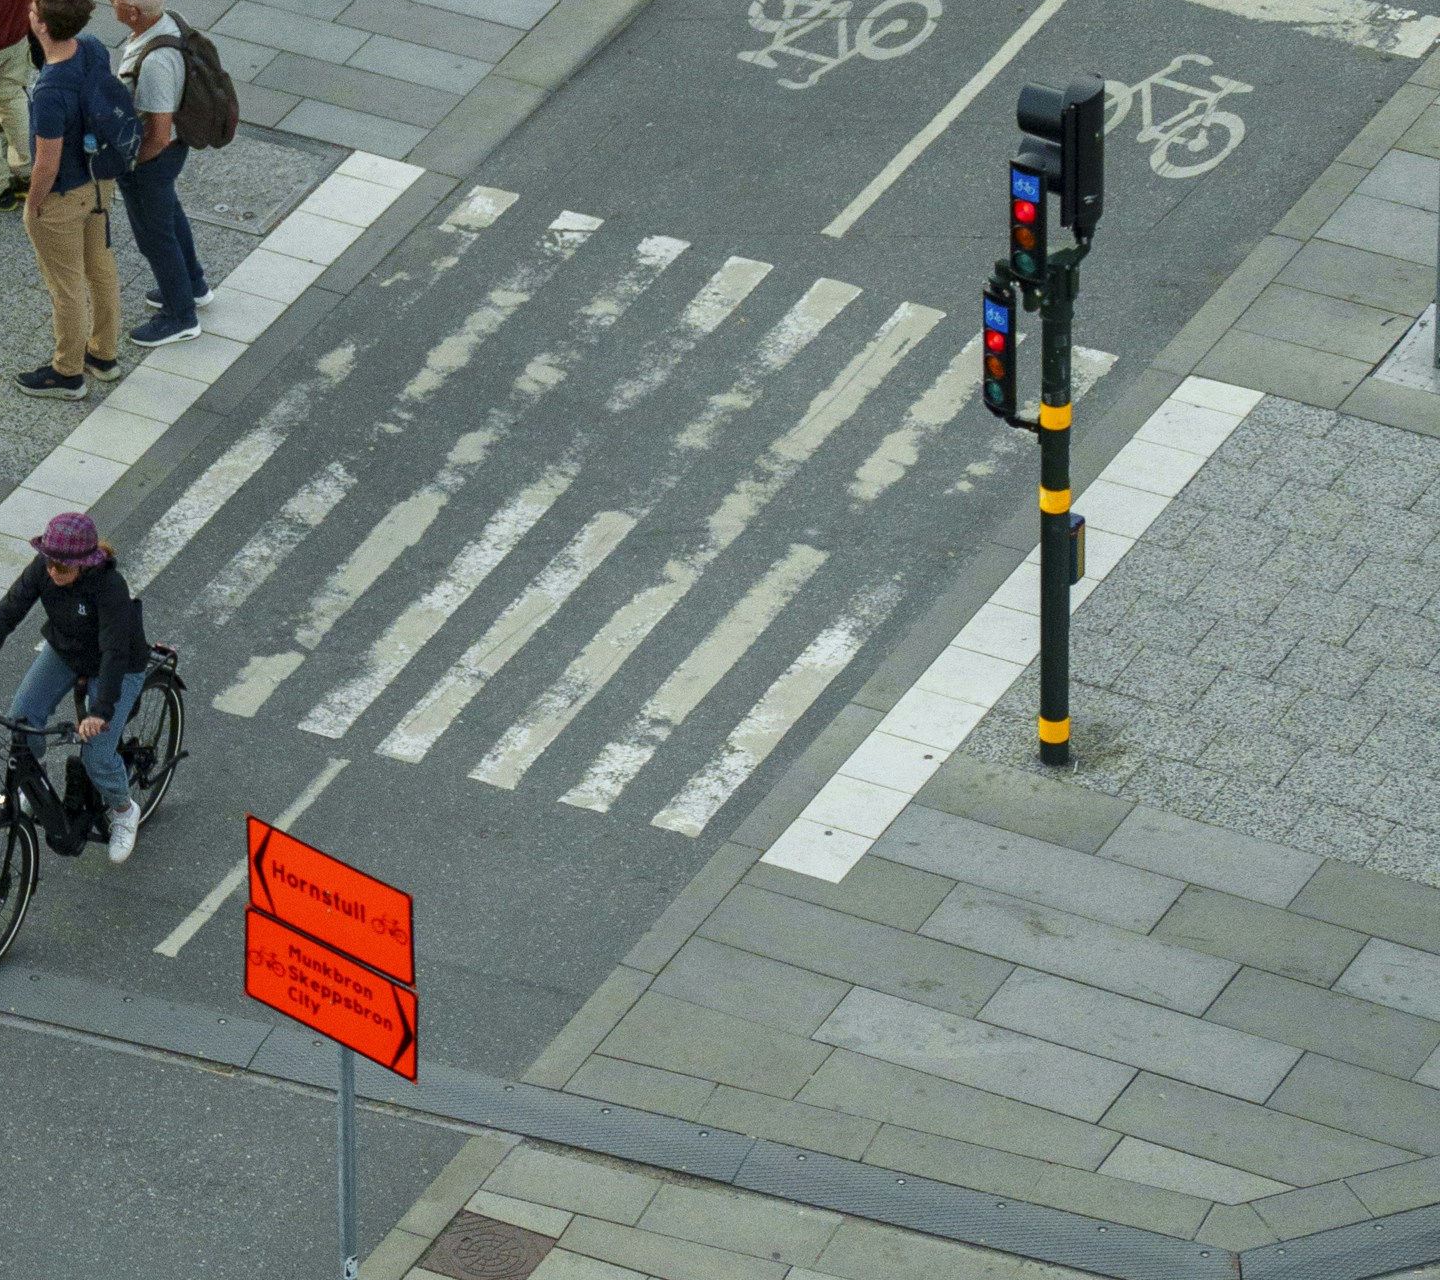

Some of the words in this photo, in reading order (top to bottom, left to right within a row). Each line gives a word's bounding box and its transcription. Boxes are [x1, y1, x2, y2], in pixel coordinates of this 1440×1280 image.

[271, 859, 366, 924] Hornstull
[287, 986, 321, 1016] City
[288, 944, 374, 1001] Munkbron
[288, 965, 394, 1032] Skeppsbron
